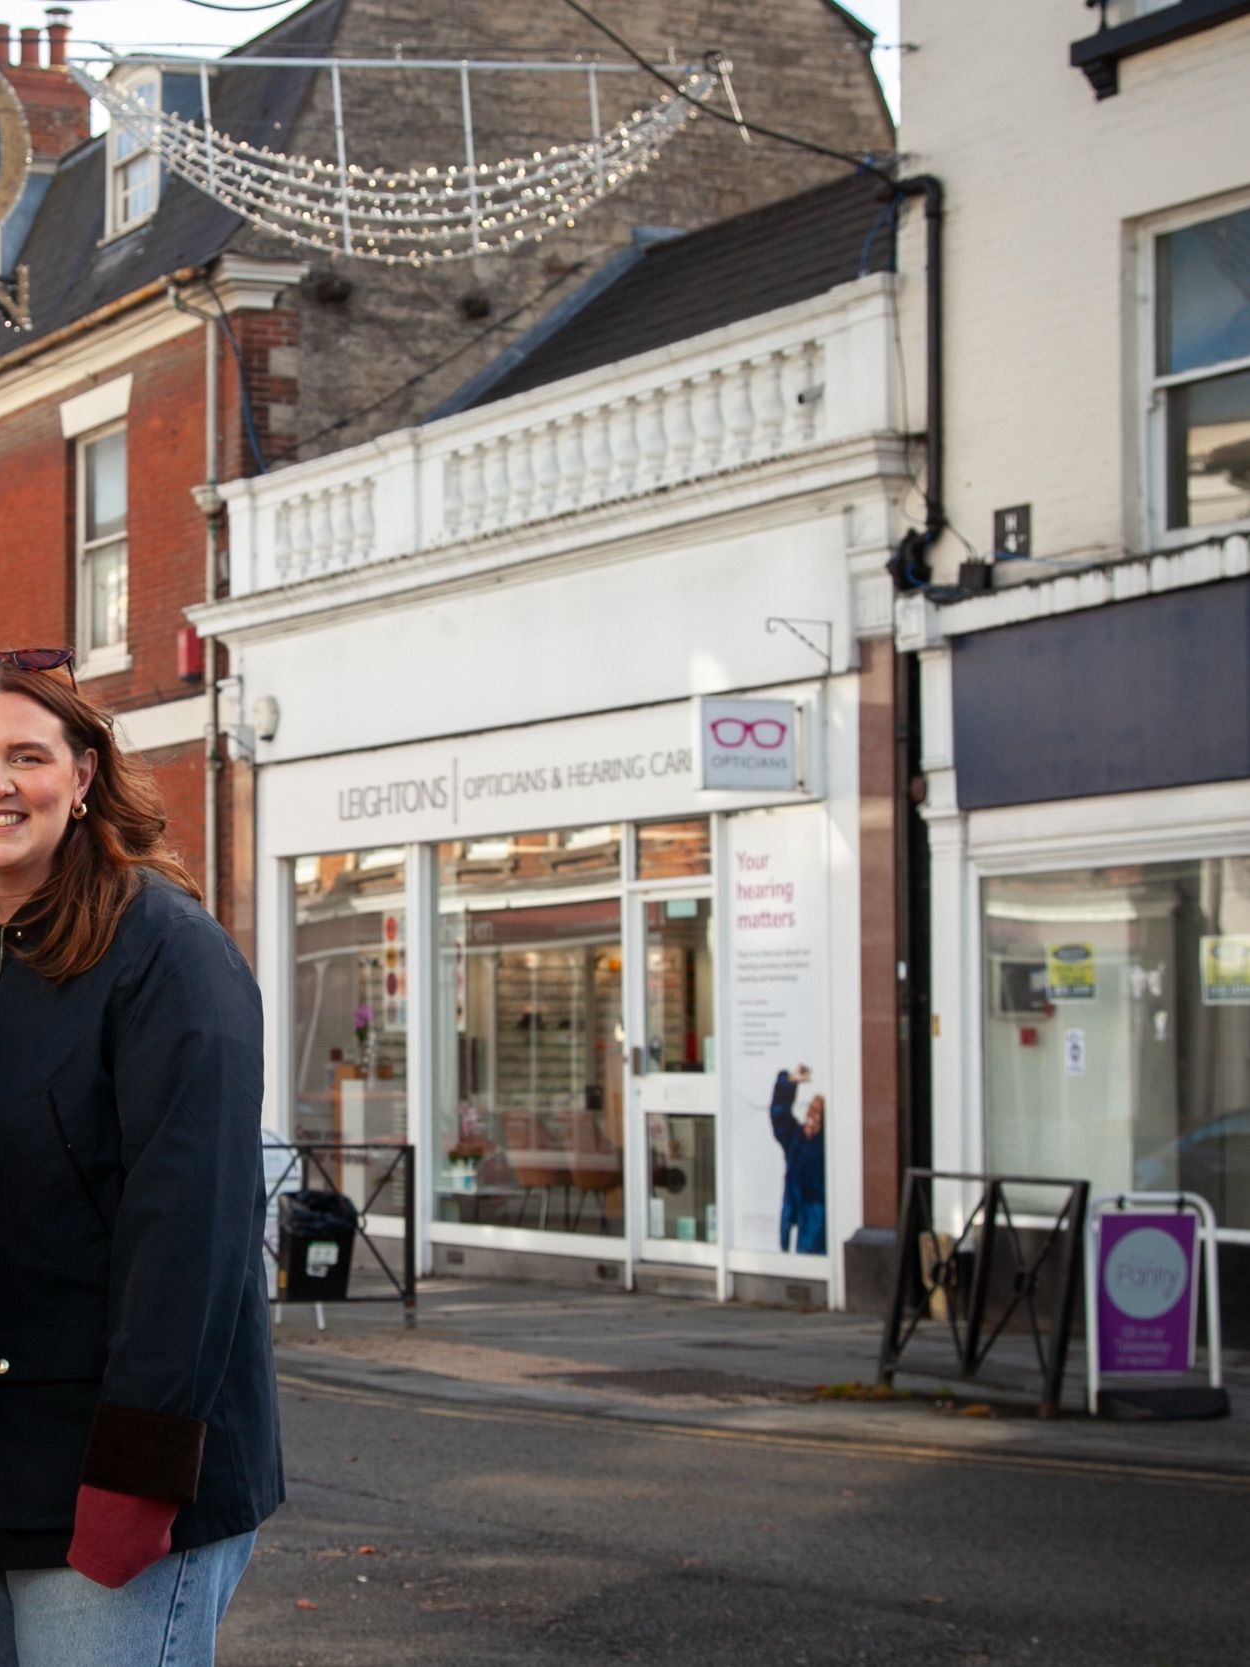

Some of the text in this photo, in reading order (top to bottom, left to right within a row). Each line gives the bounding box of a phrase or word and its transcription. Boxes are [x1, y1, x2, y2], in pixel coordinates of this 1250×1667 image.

[711, 755, 789, 770] OPTICIANS
[338, 775, 449, 822] LEIGHTONS
[463, 766, 547, 801] OPTICIANS
[551, 763, 562, 789] &
[567, 754, 645, 787] HEARING
[735, 851, 770, 871] Your
[736, 877, 794, 902] hearing
[736, 910, 796, 930] matters
